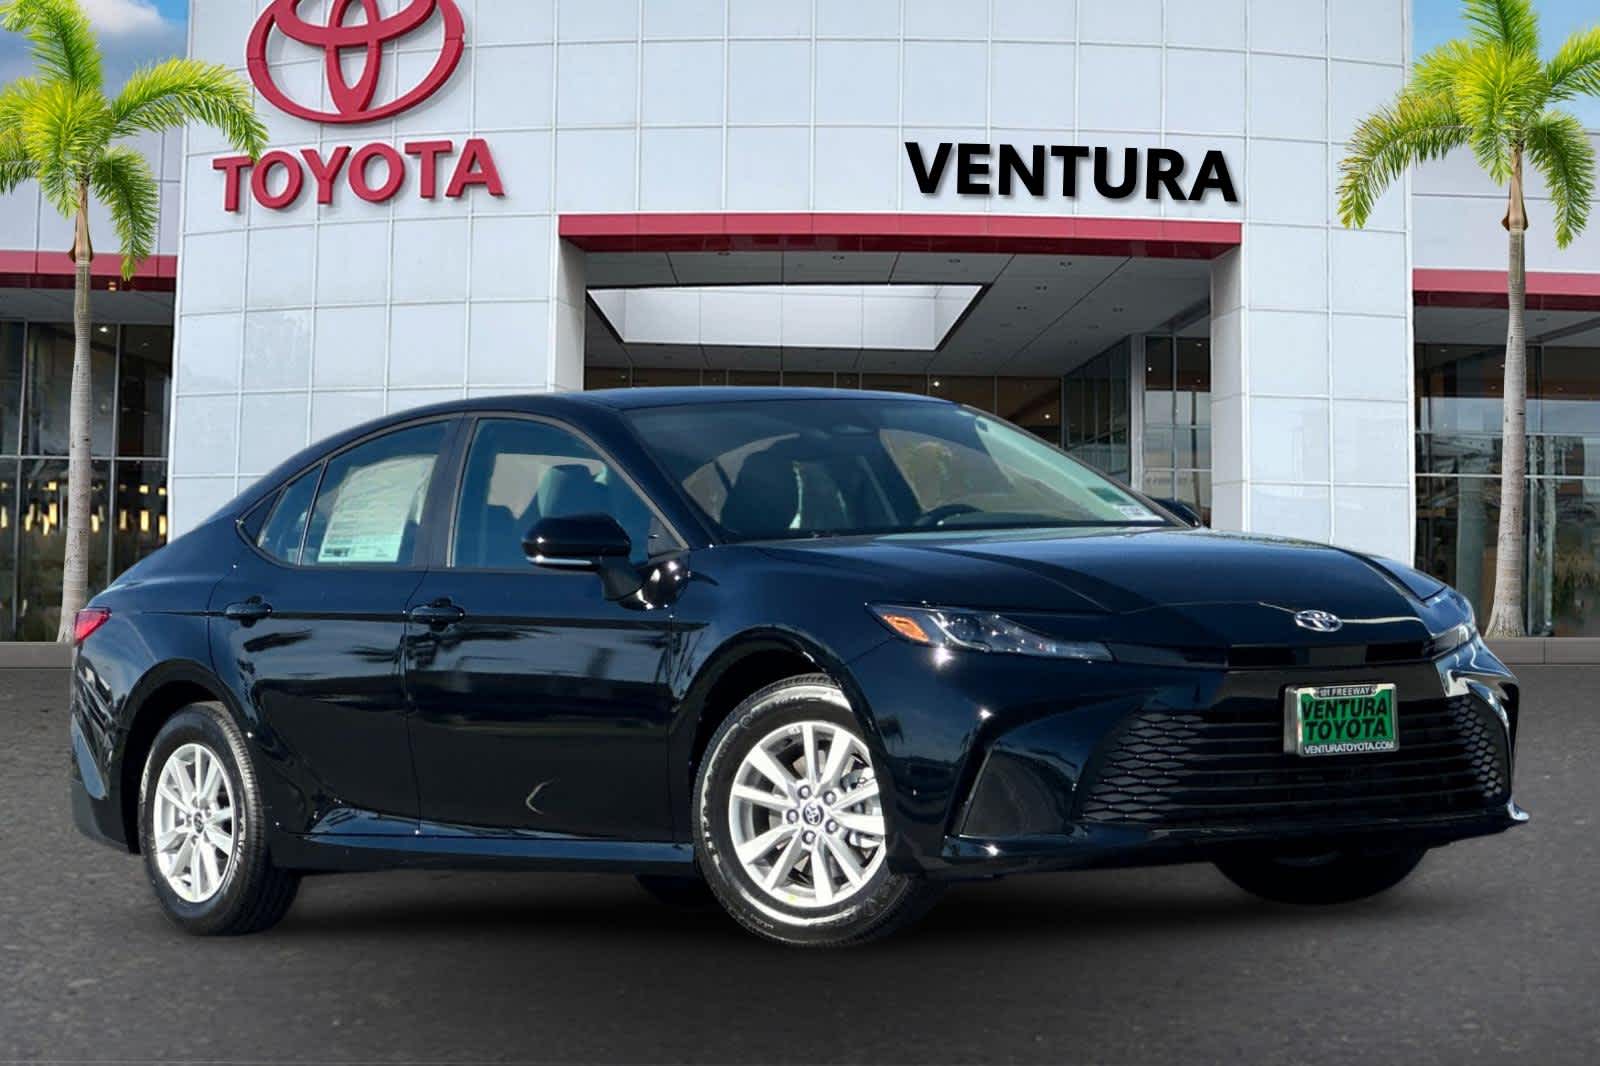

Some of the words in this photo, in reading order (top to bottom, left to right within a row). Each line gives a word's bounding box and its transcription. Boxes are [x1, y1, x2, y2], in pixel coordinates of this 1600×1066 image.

[213, 139, 505, 212] TOYOTA
[904, 141, 1237, 203] VENTURA
[1332, 687, 1370, 696] FREEWAY
[1302, 697, 1387, 720] VENTURA
[1305, 718, 1387, 741] TOYOTA
[1304, 741, 1394, 754] VENTURATOYOTA.COM
